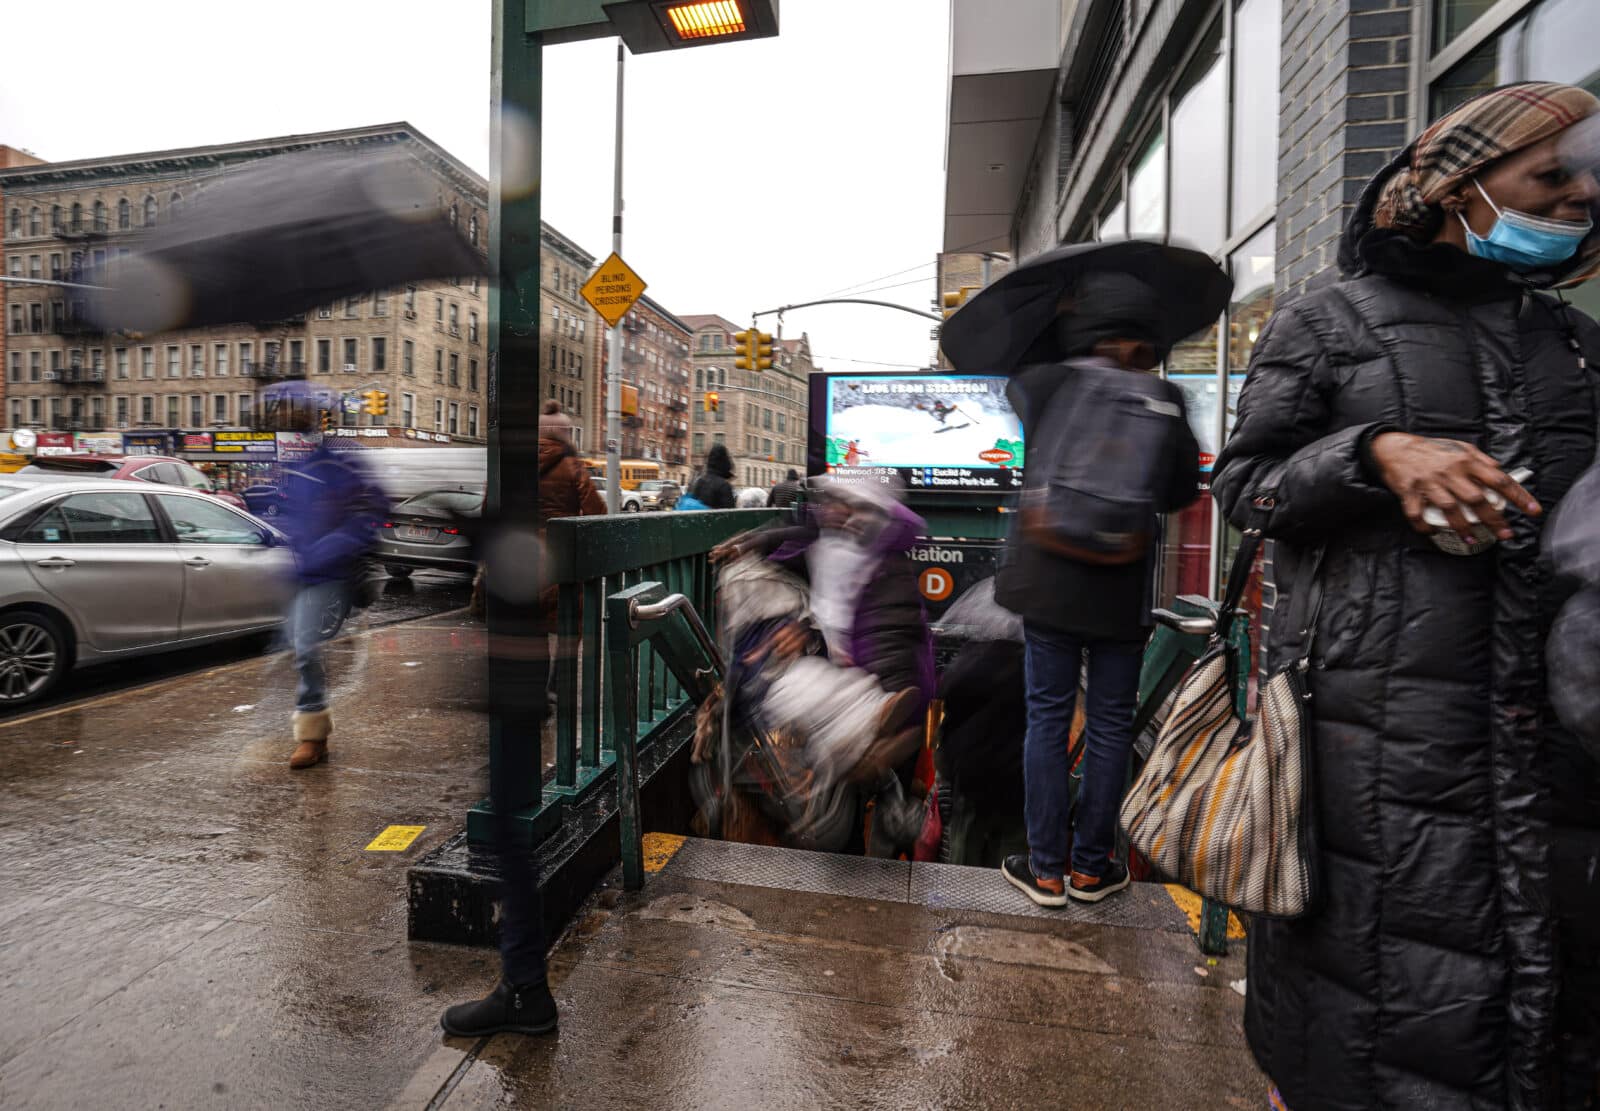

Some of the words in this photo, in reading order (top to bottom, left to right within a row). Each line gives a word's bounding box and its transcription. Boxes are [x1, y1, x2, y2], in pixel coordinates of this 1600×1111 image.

[601, 274, 625, 282] BLIND
[593, 295, 633, 305] CROSSING
[861, 383, 889, 393] LIVE
[891, 383, 924, 393] FROM
[888, 467, 898, 476] St
[932, 468, 959, 477] Euclid
[926, 574, 945, 594] D
